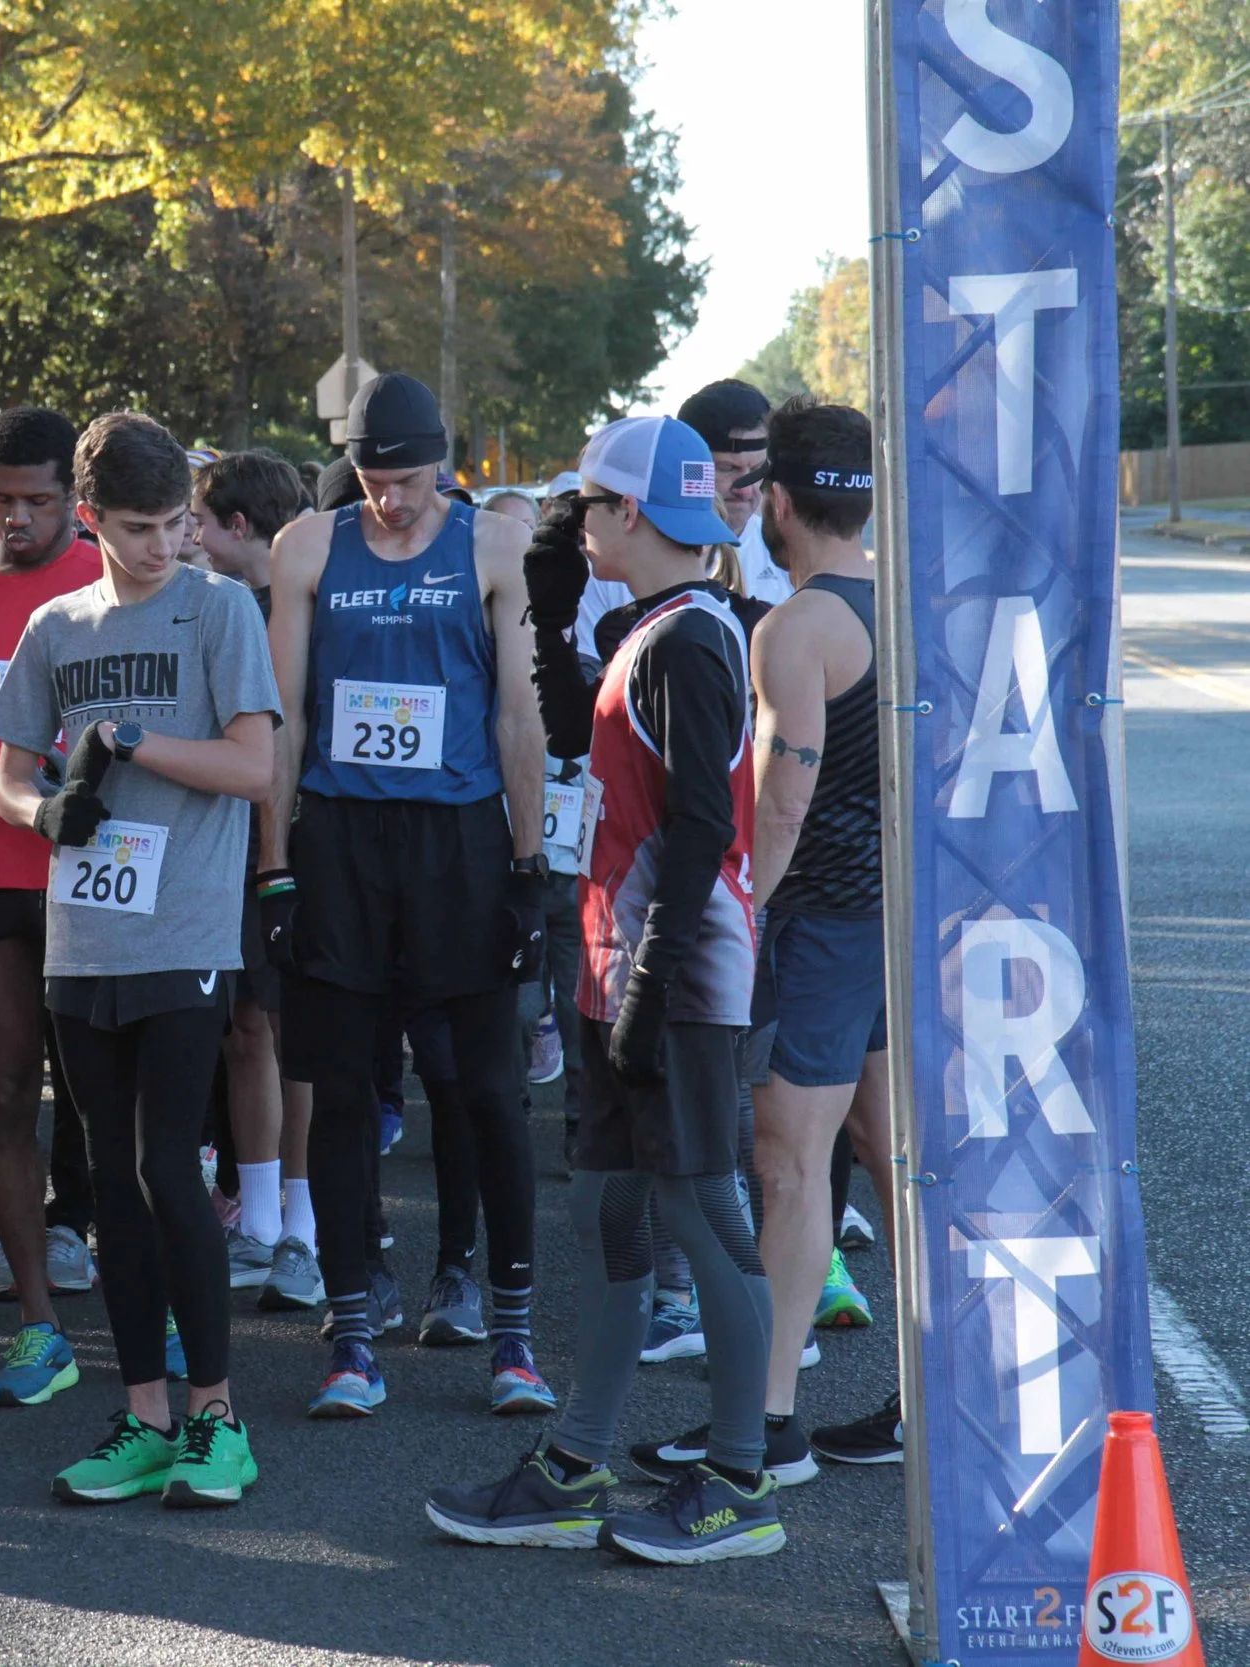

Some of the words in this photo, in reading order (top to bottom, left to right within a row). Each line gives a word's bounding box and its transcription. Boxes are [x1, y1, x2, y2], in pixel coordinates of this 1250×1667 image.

[814, 471, 839, 486] ST.
[844, 474, 874, 488] JUD
[330, 589, 387, 609] FLEET
[409, 588, 459, 606] FEET
[371, 614, 413, 625] MEMPHIS
[54, 653, 178, 710] HOUSTON
[349, 694, 430, 713] MEMPHIS
[941, 0, 1100, 1455] START
[352, 722, 421, 762] 239
[546, 791, 575, 806] PHIS
[87, 832, 151, 853] MPHIS
[71, 860, 137, 905] 260
[1096, 1579, 1175, 1637] S2F
[968, 1634, 1016, 1649] EVENT
[1101, 1638, 1176, 1657] s2fevents.com
